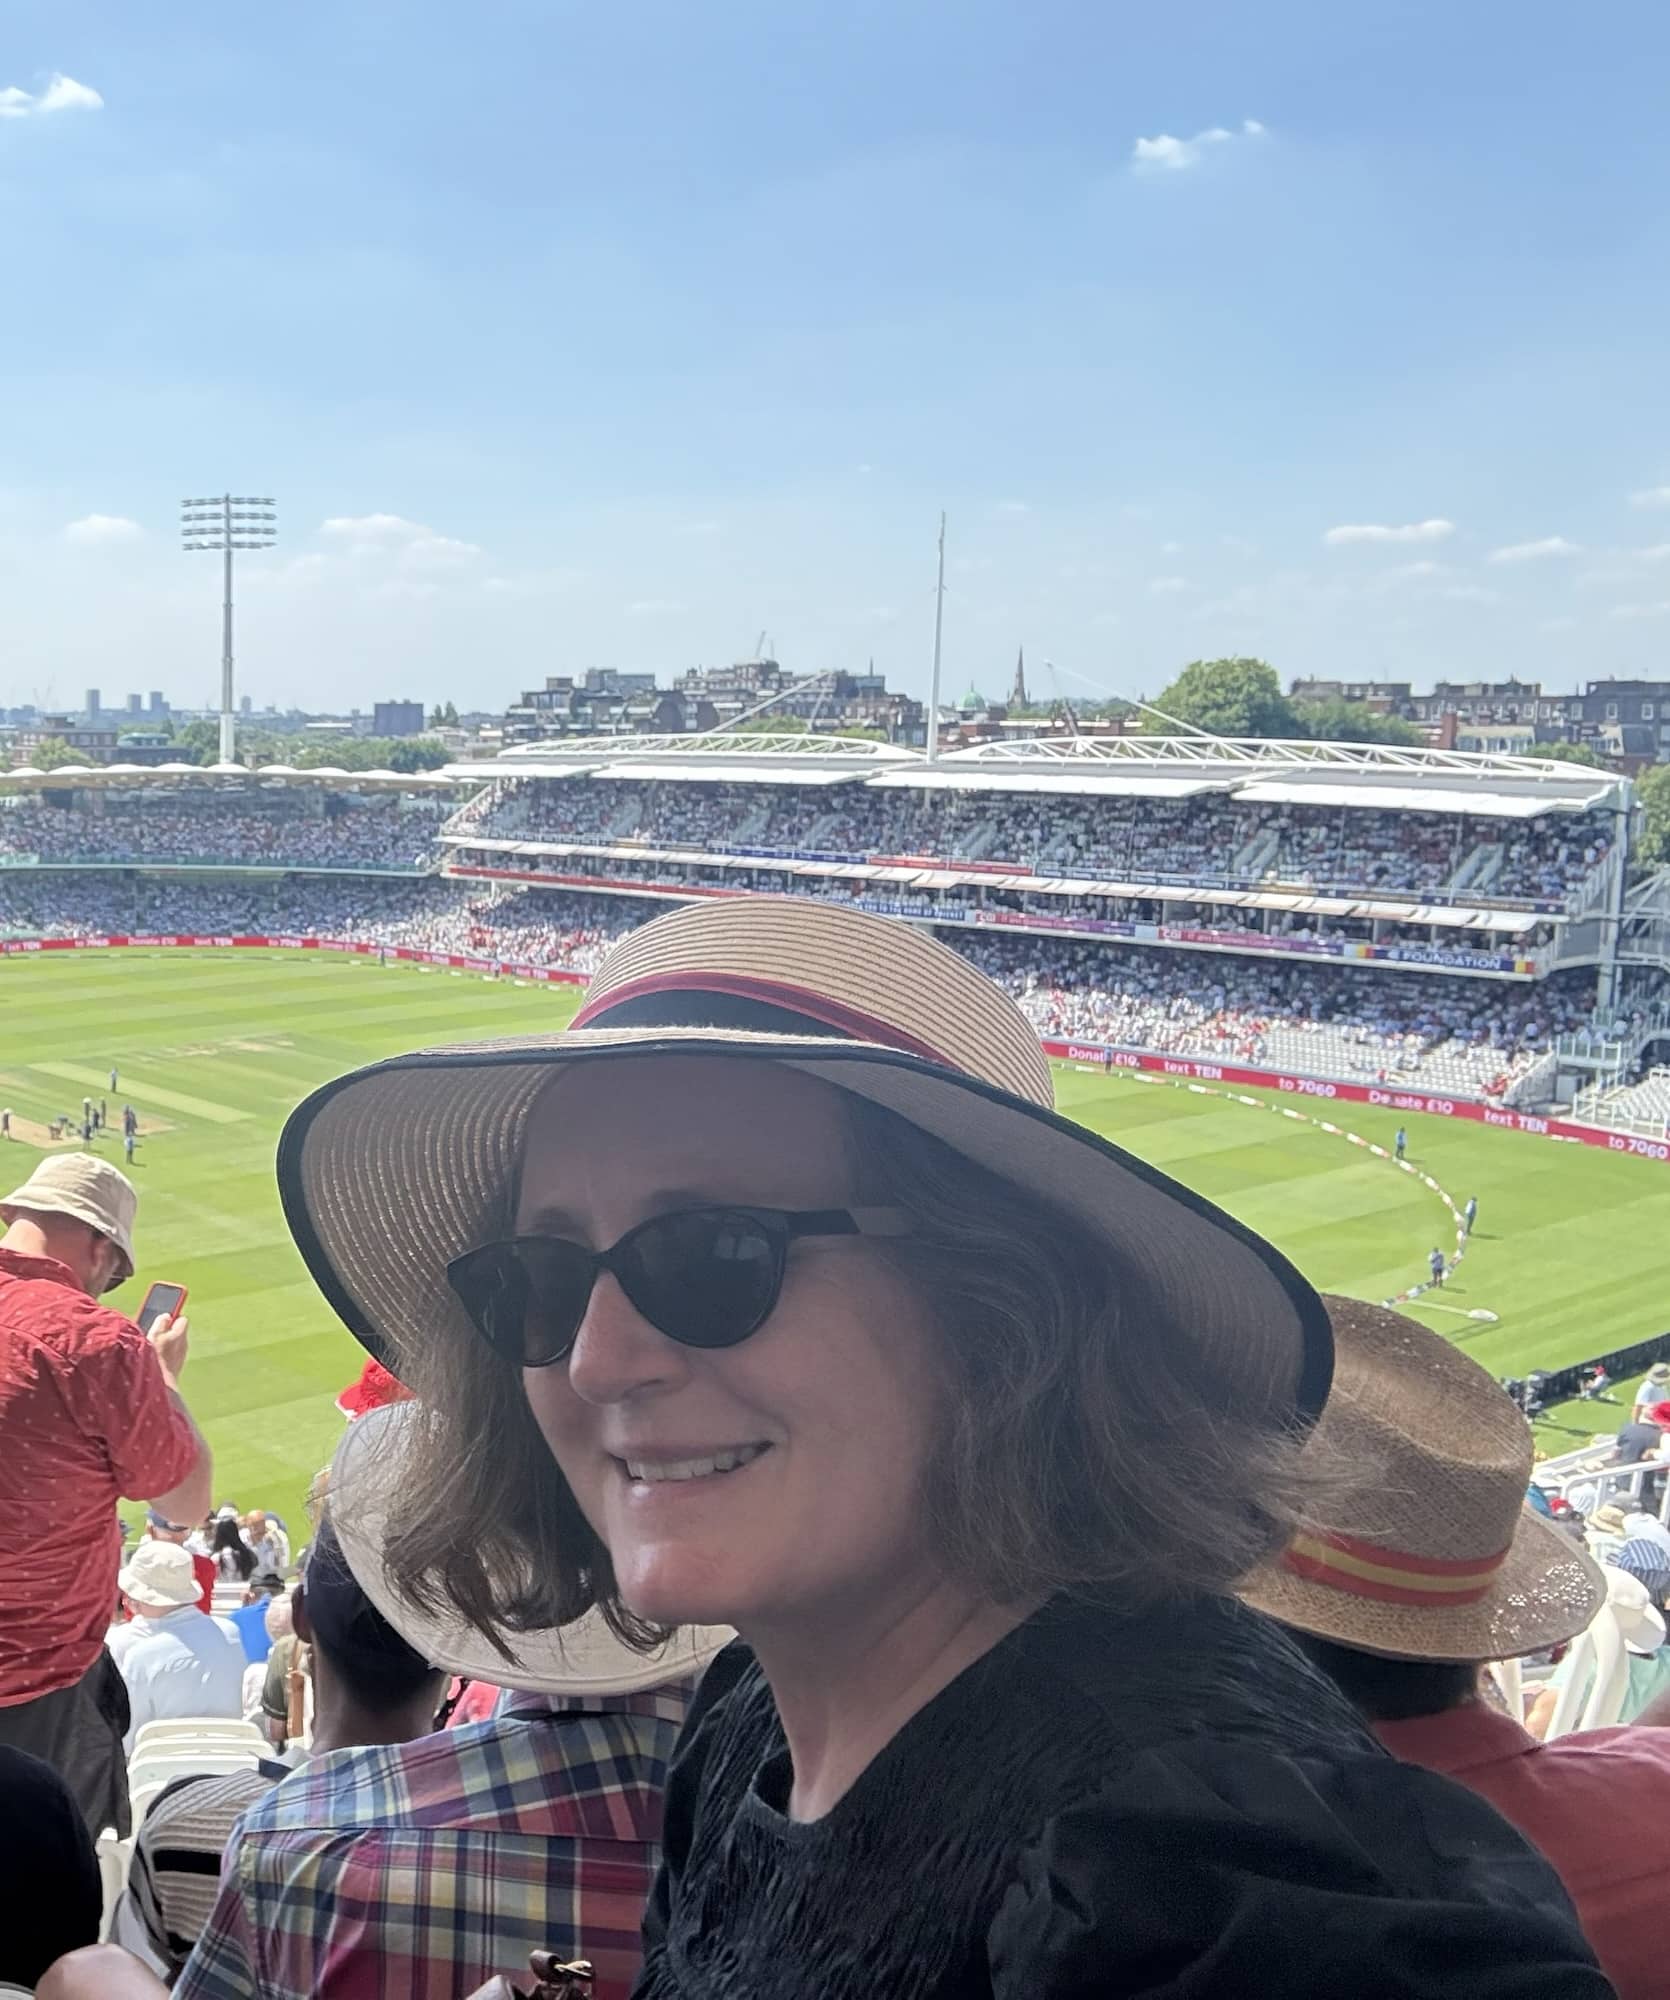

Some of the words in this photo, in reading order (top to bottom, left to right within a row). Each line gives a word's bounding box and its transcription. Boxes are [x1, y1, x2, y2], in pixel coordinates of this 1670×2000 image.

[1403, 951, 1501, 969] FOUNDATION
[1068, 1046, 1107, 1063] Donat
[1164, 1060, 1189, 1075] text
[1194, 1063, 1222, 1080] TEN
[1279, 1076, 1294, 1091] to
[1297, 1080, 1337, 1098] 7060
[1484, 1109, 1514, 1127] text
[1518, 1112, 1549, 1133] TEN
[1608, 1135, 1625, 1150] to
[1627, 1138, 1669, 1160] 7060
